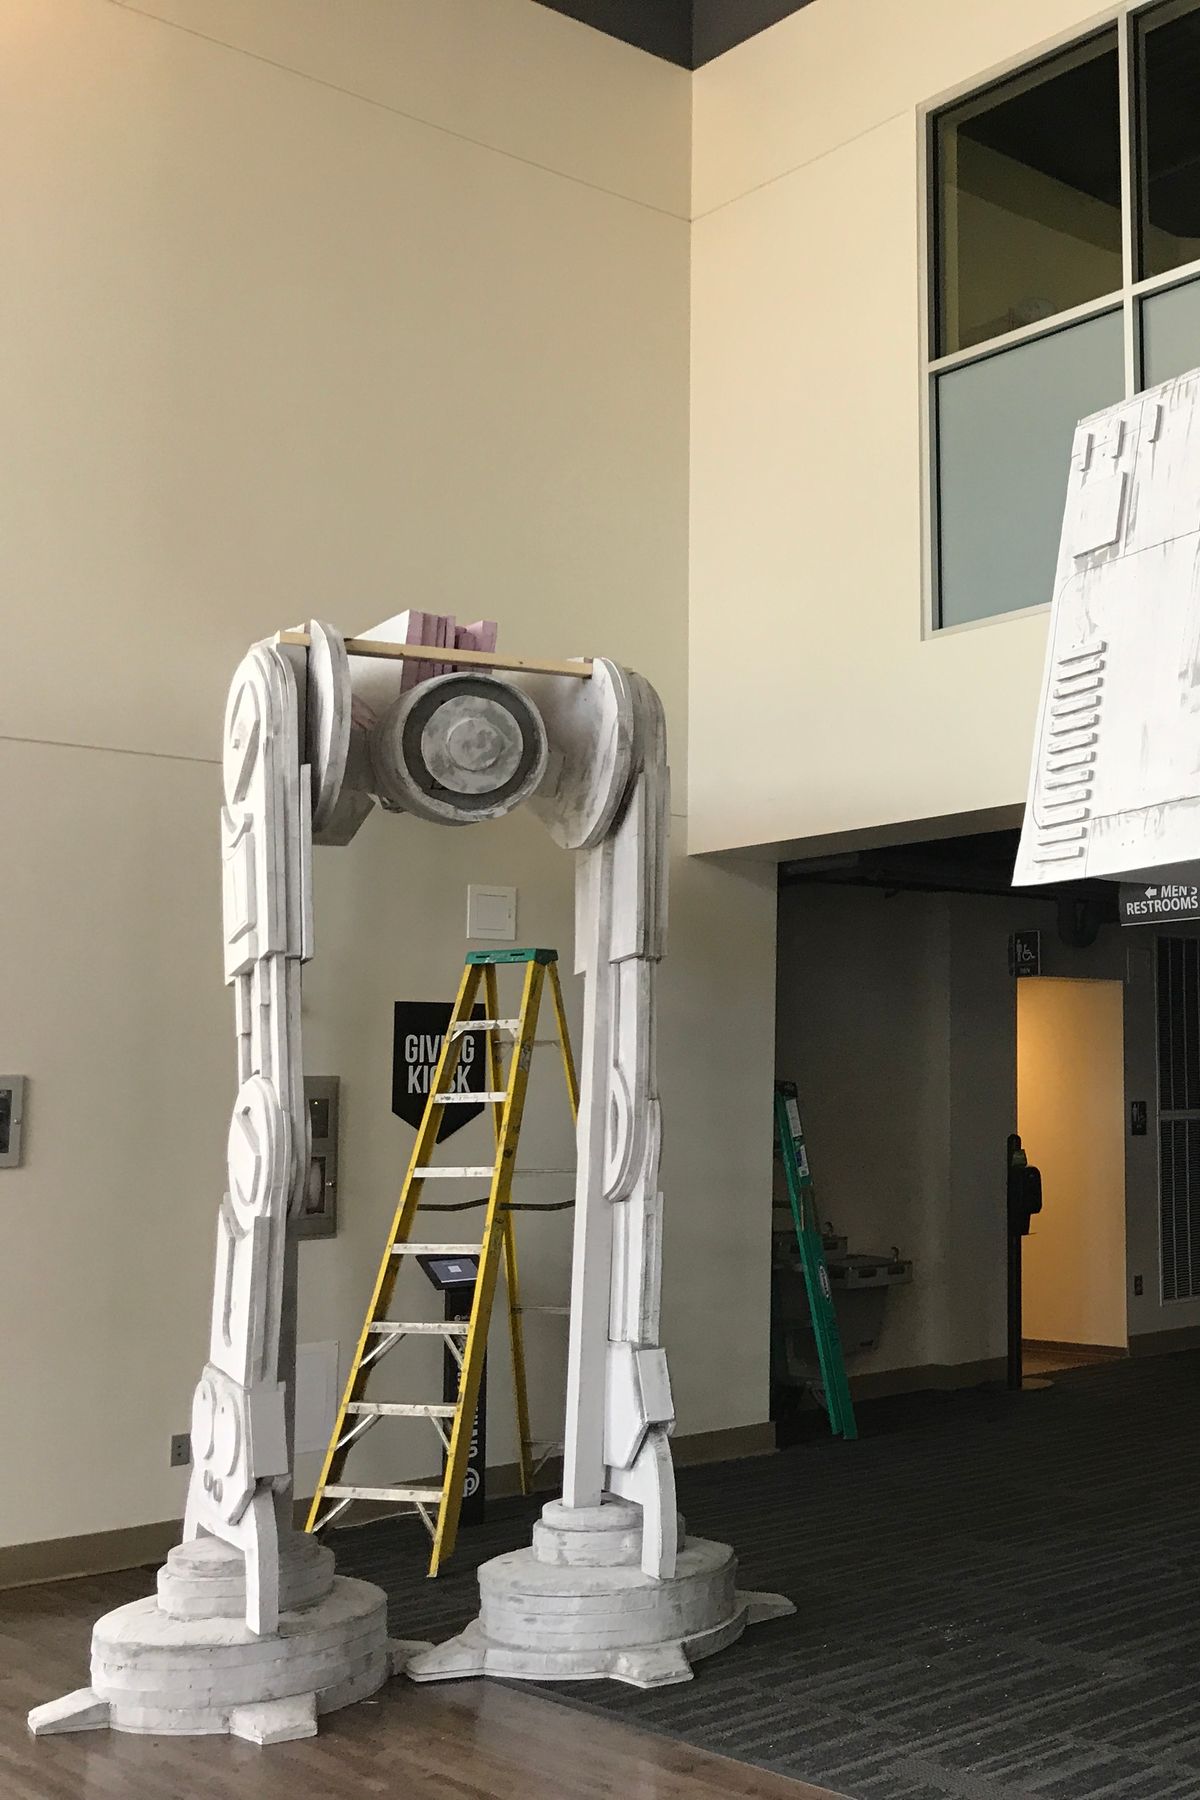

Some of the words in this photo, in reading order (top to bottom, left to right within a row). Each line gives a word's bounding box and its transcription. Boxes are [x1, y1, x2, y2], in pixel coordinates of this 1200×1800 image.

[1161, 885, 1198, 898] MENS
[1126, 896, 1199, 915] RESTROOMS
[405, 1034, 475, 1063] GIVG
